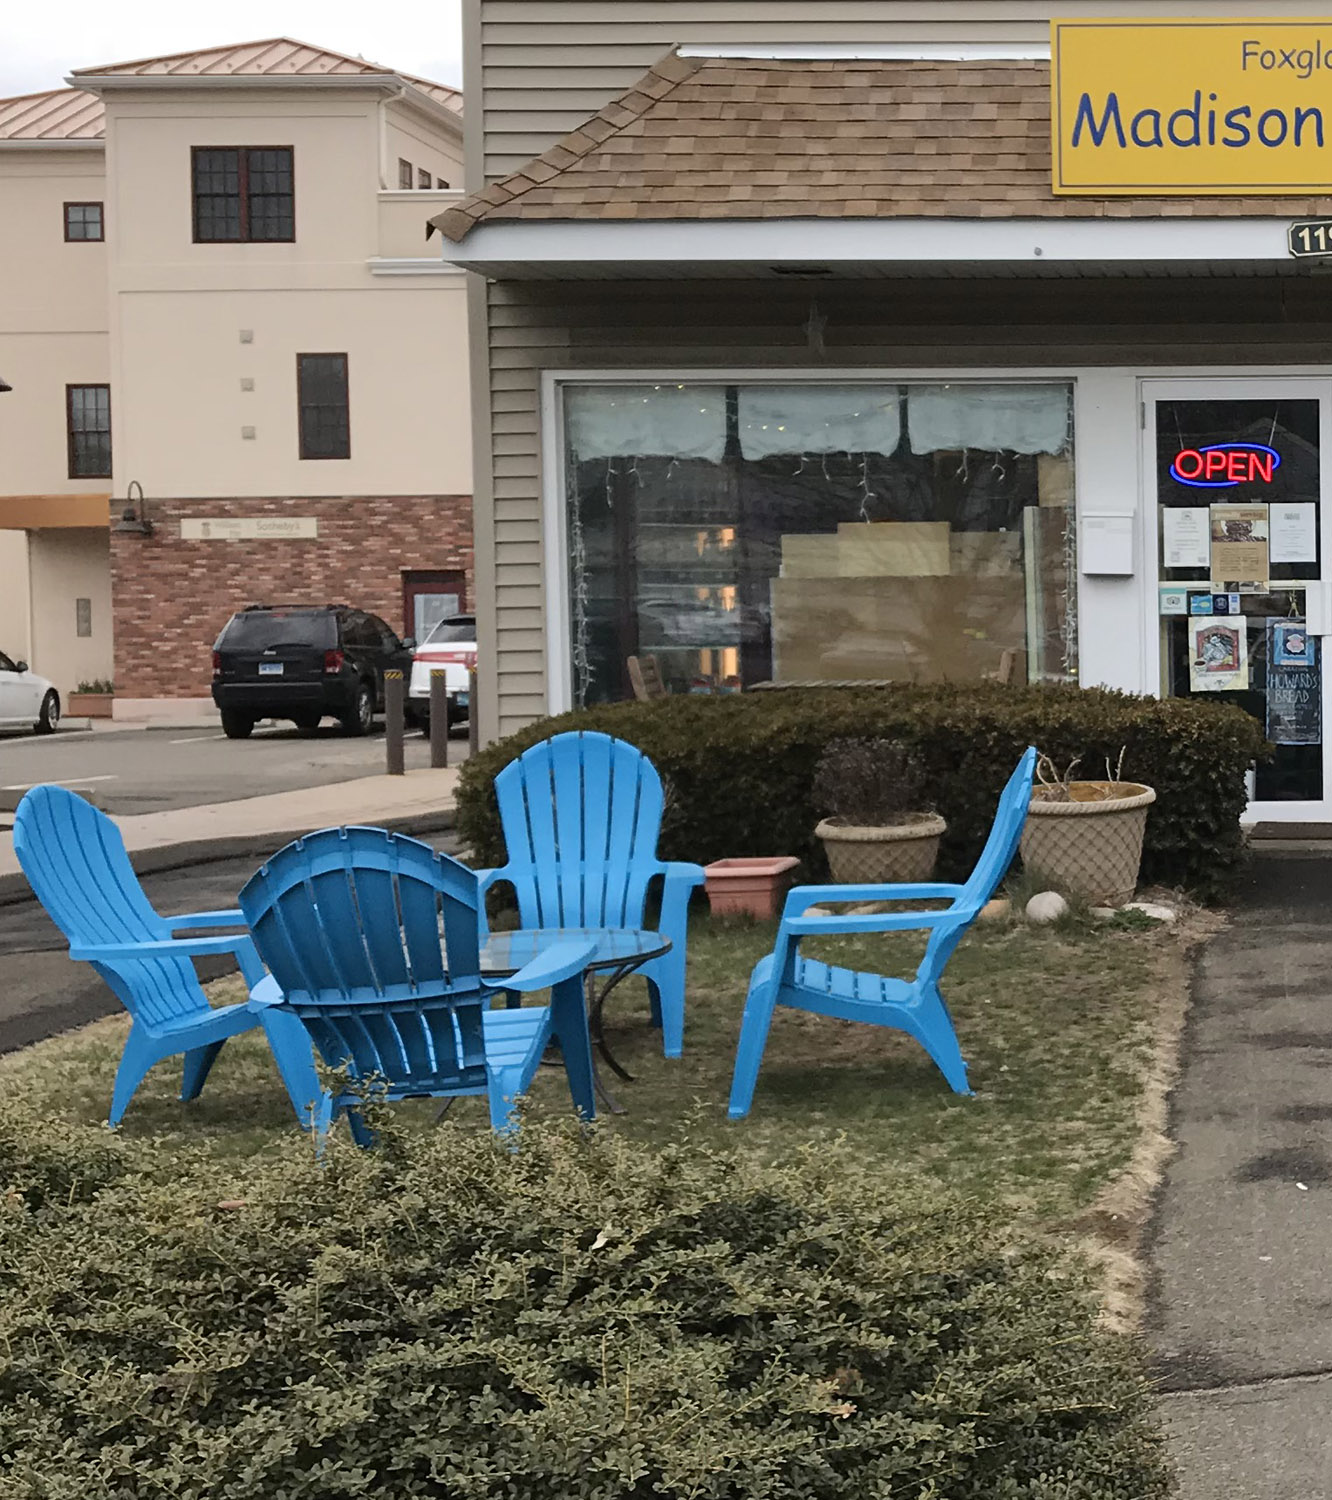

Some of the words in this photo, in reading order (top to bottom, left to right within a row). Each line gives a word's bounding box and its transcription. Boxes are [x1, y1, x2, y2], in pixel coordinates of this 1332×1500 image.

[1071, 89, 1325, 149] Madison
[1174, 449, 1273, 483] OPEN
[1274, 689, 1310, 704] BREAD
